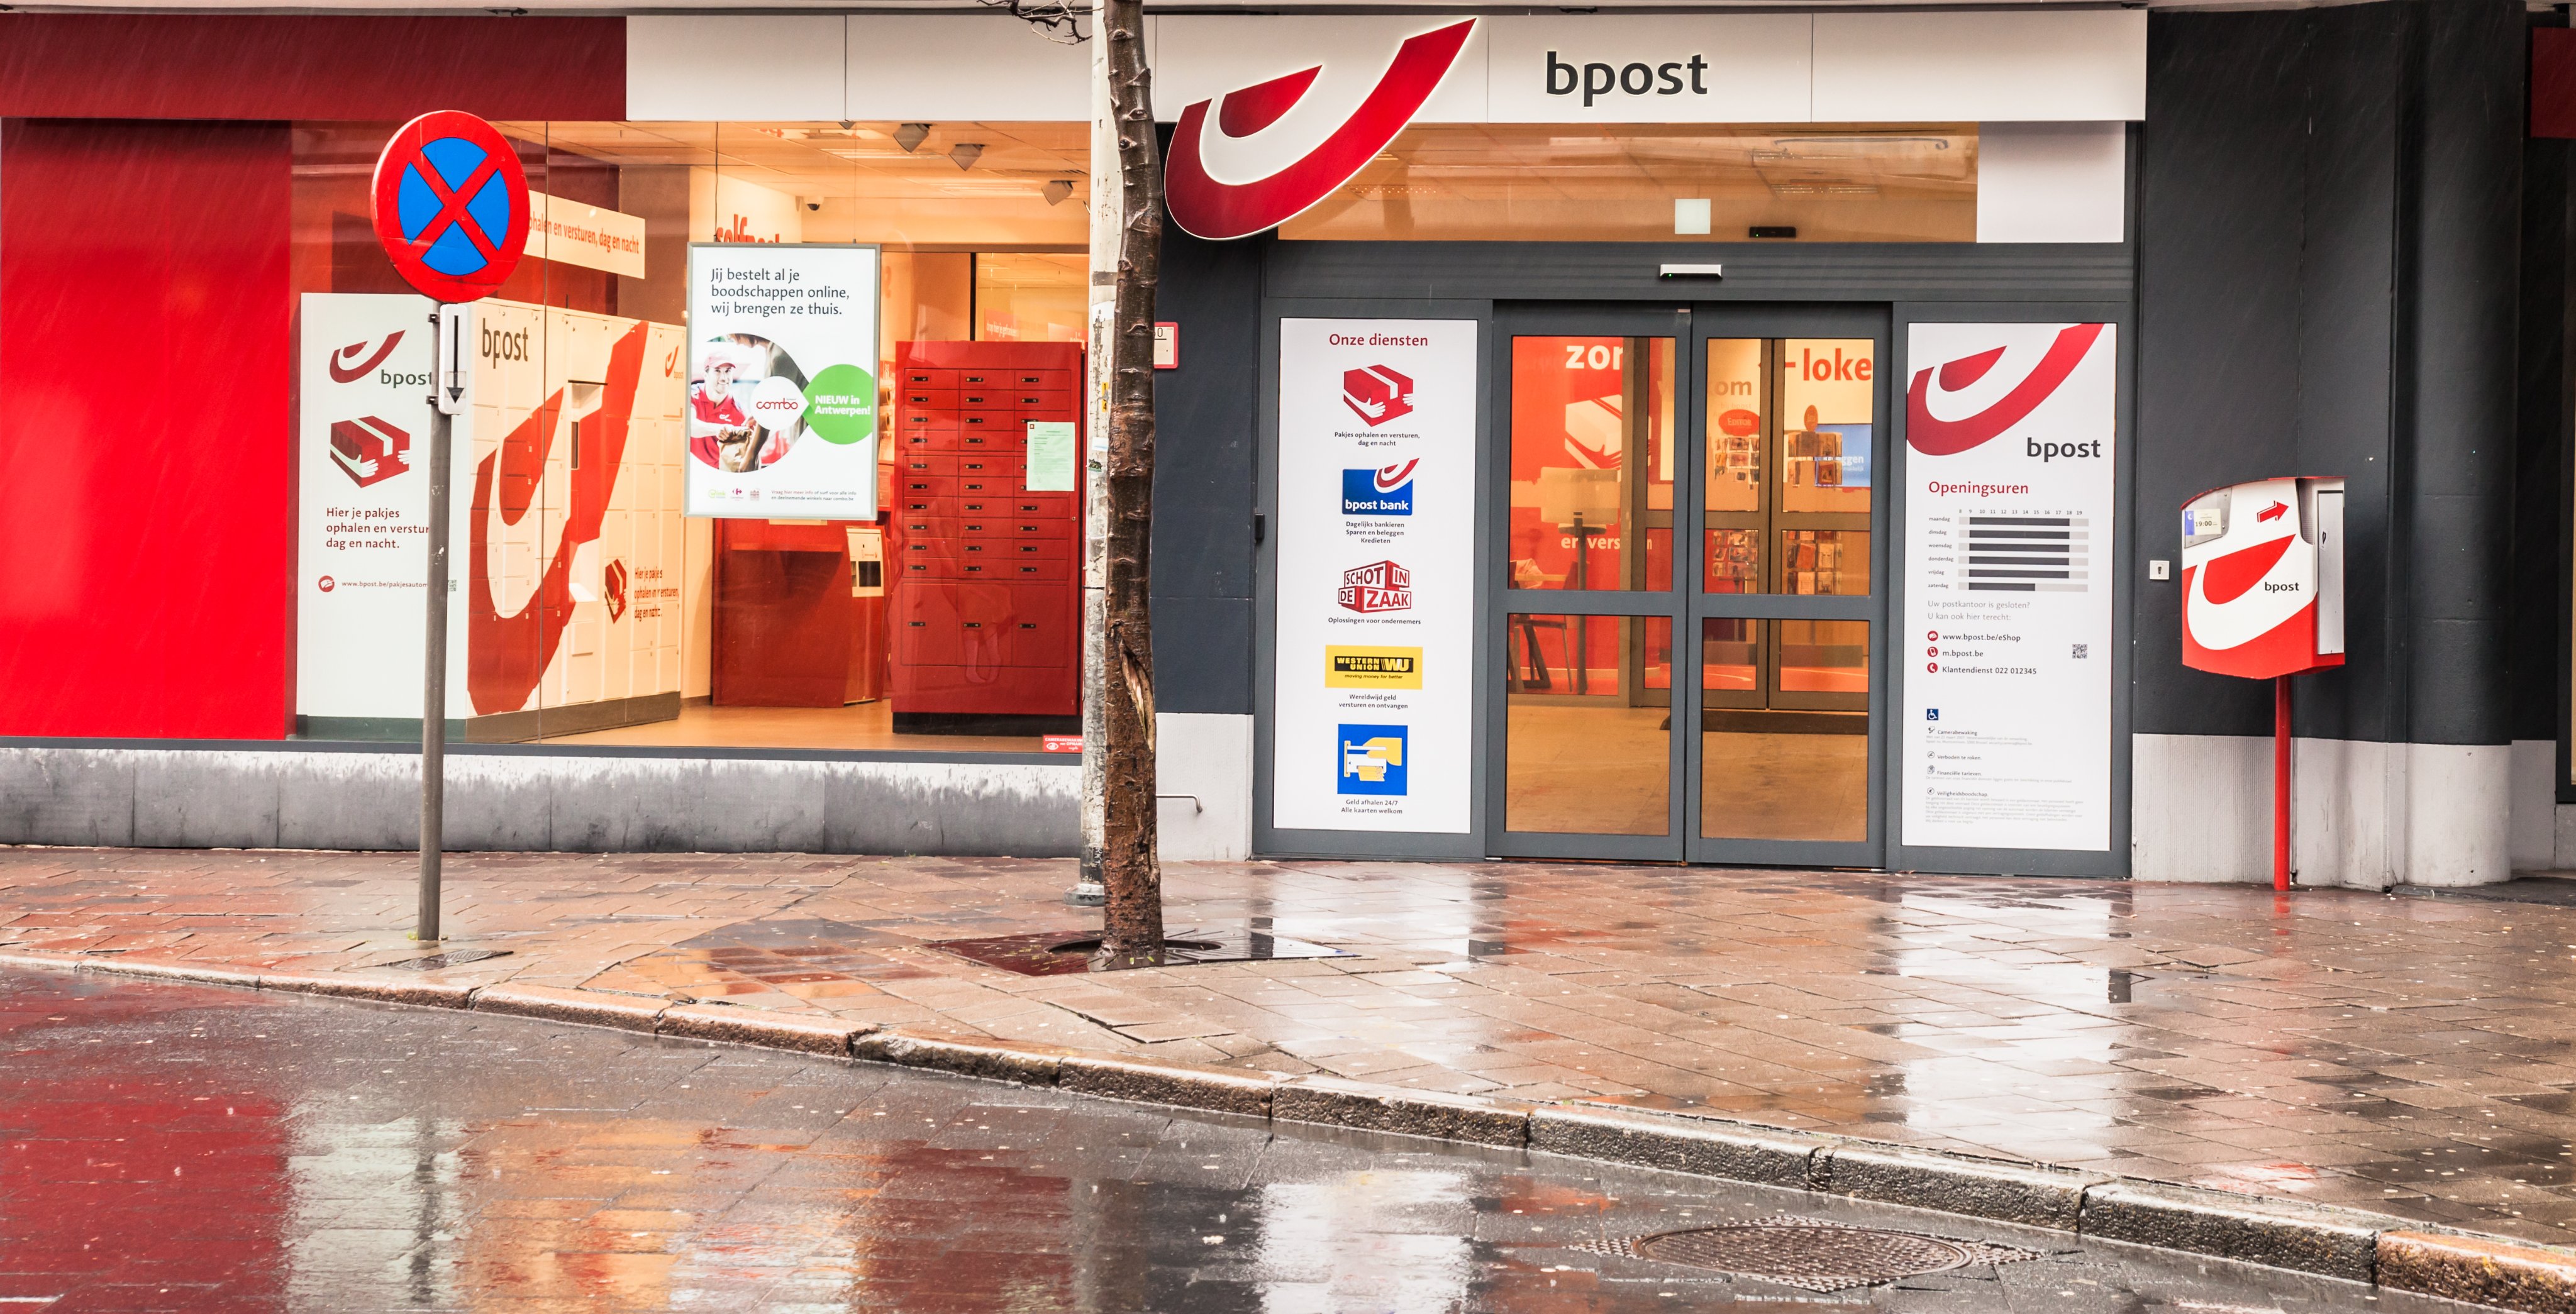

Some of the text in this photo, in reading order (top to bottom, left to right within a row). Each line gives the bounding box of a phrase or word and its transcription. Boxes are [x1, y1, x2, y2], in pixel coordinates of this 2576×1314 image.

[1546, 50, 1708, 108] bpost
[554, 223, 562, 236] en
[564, 225, 597, 245] versturen,
[599, 228, 611, 253] dag
[613, 236, 620, 250] en
[621, 235, 639, 254] nacht
[711, 267, 800, 284] Jij bestelt al je
[711, 284, 850, 301] boodschappen online,
[711, 301, 842, 318] wij brengen ze thuis.
[482, 317, 529, 369] bpost
[1329, 333, 1428, 346] Onze diensten
[380, 369, 433, 389] bpost
[757, 397, 798, 409] combo
[815, 395, 860, 404] NIEUW in
[814, 406, 870, 417] Antwerpen!
[1334, 431, 1354, 439] Pakjes
[1355, 431, 1379, 439] ophalen
[1358, 439, 1369, 448] dag
[2027, 437, 2101, 463] bpost
[1928, 480, 2028, 498] Openingsuren
[1345, 500, 1409, 511] bpost bank
[326, 507, 400, 521] Hier je pakjes
[326, 522, 430, 535] ophalen en verstur
[1346, 521, 1373, 529] Dagelijks
[1377, 529, 1404, 537] beleggen
[326, 537, 346, 551] dag
[365, 538, 400, 549] nacht.
[1346, 566, 1407, 585] SCHOT IN
[2264, 581, 2300, 594] bpost
[1340, 590, 1409, 608] DE ZAAK
[1942, 600, 1986, 610] postkantoor
[1996, 600, 2031, 611] gesloten?
[1328, 617, 1365, 626] Oplossingen
[1950, 612, 1964, 621] ook
[1967, 612, 1980, 621] hier
[1942, 633, 2021, 643] www.bpost.be/eShop
[1942, 649, 1984, 658] m.bpost.be
[1384, 658, 1410, 671] WU
[1942, 666, 1993, 674] Klantendienst
